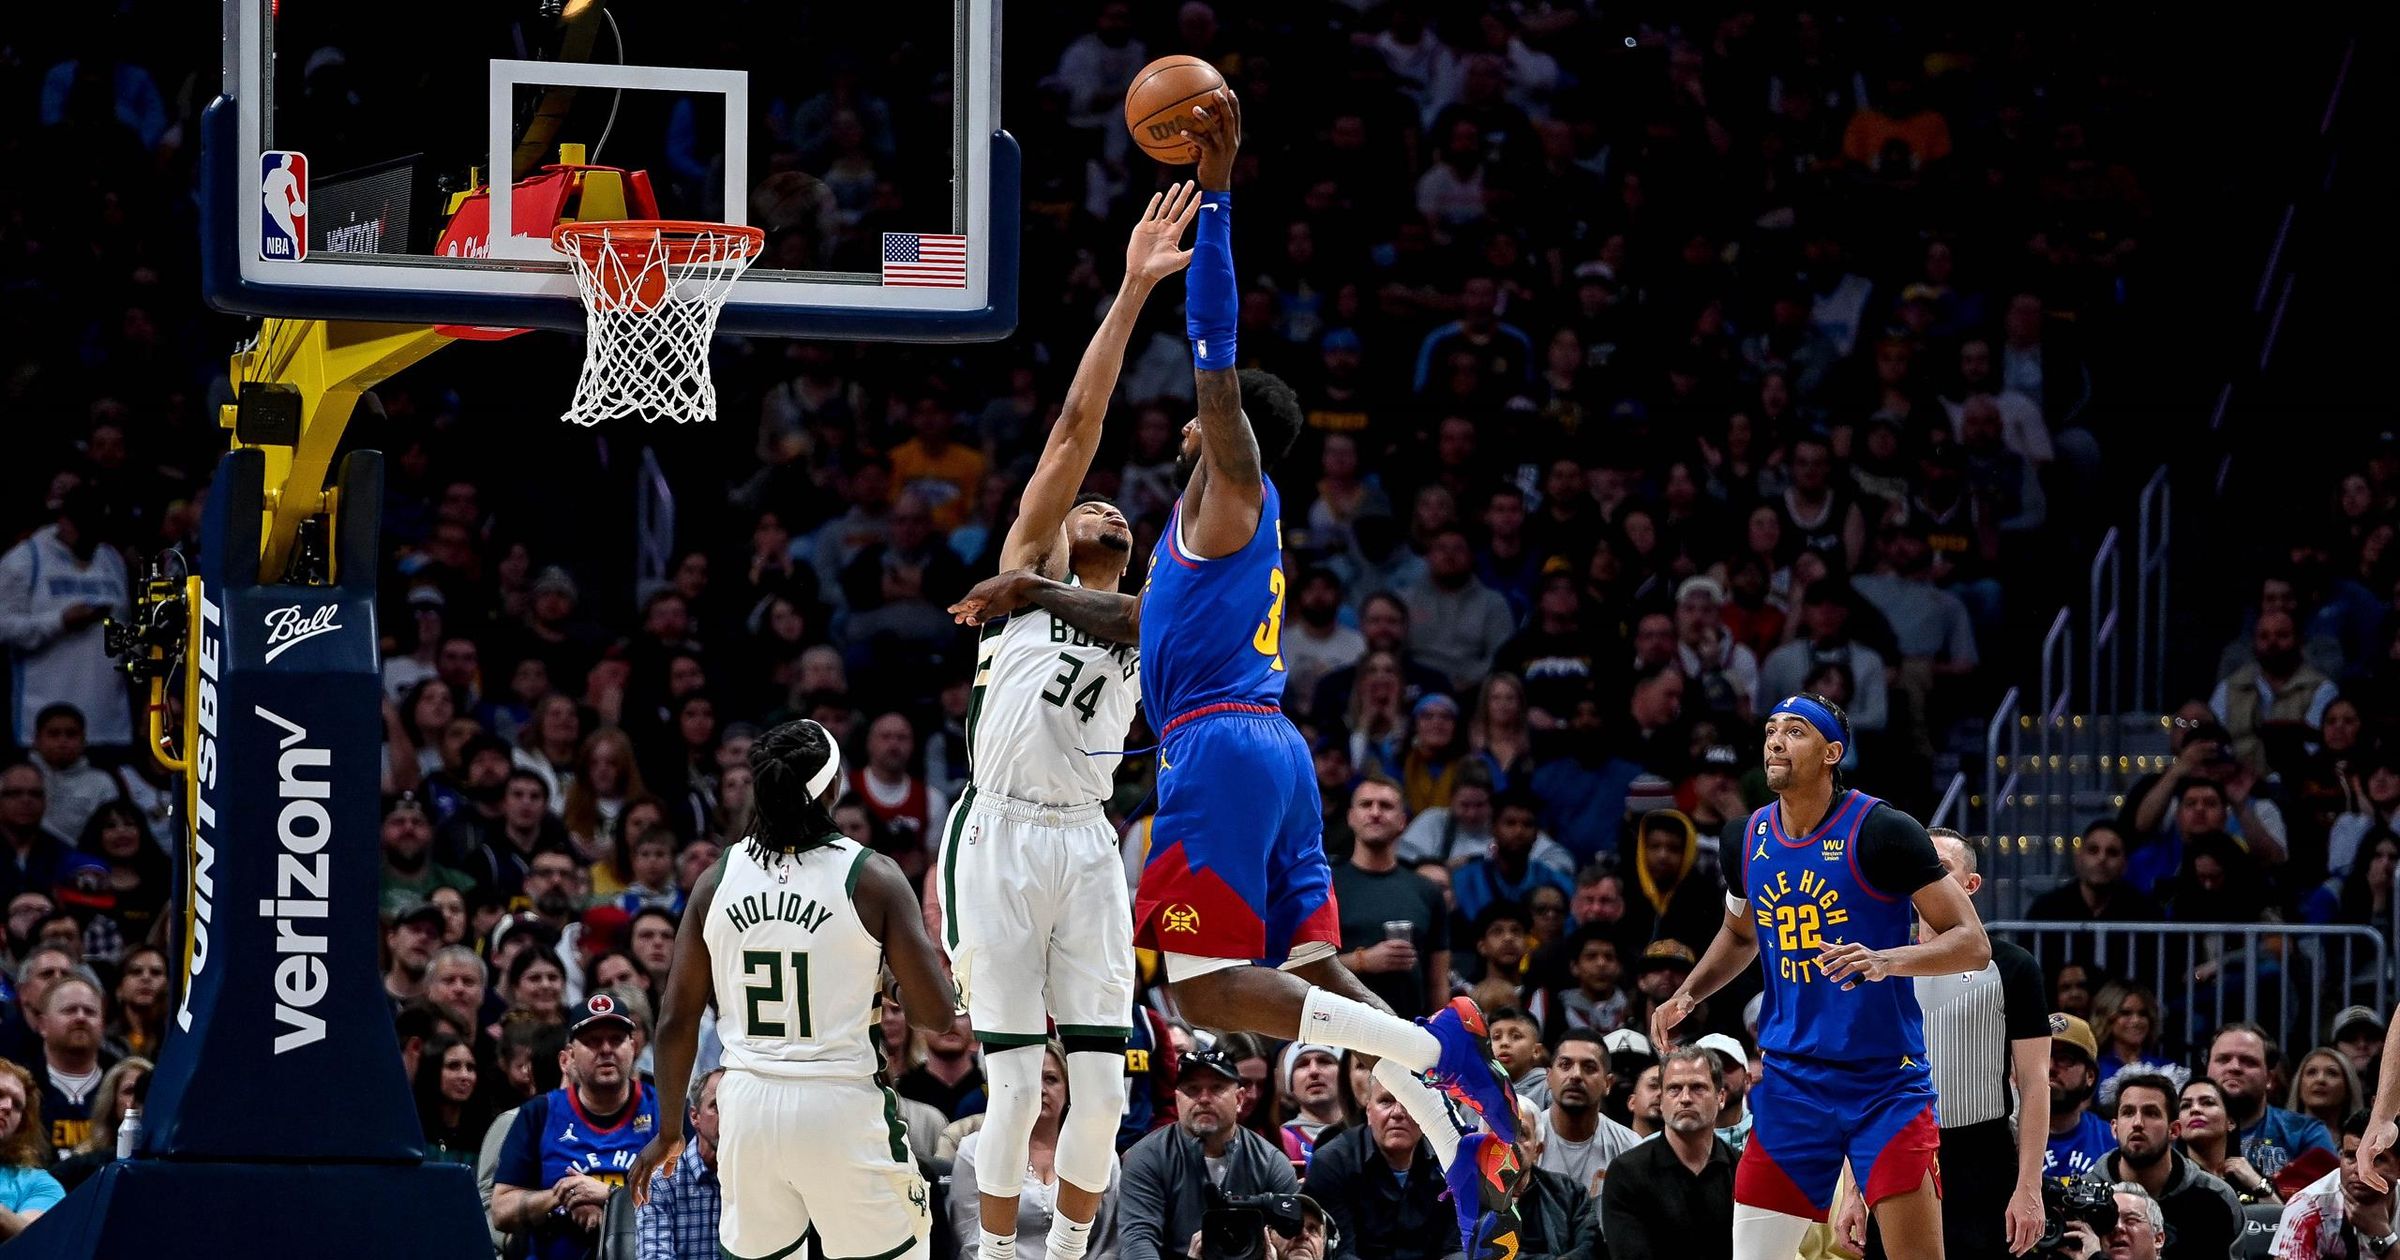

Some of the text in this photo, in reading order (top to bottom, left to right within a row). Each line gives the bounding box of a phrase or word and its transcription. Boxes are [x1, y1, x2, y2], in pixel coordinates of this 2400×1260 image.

[266, 236, 289, 254] NBA
[327, 212, 379, 254] verizon
[264, 603, 342, 645] Ball
[1253, 567, 1286, 672] 3
[1041, 651, 1107, 723] 34
[1757, 821, 1768, 835] 6
[1823, 839, 1844, 850] WU
[259, 748, 332, 1055] verizon
[726, 891, 833, 934] HOLIDAY
[1756, 869, 1848, 927] MILE HIGH
[1776, 904, 1822, 950] 22
[742, 950, 814, 1039] 21
[612, 1150, 637, 1170] HI
